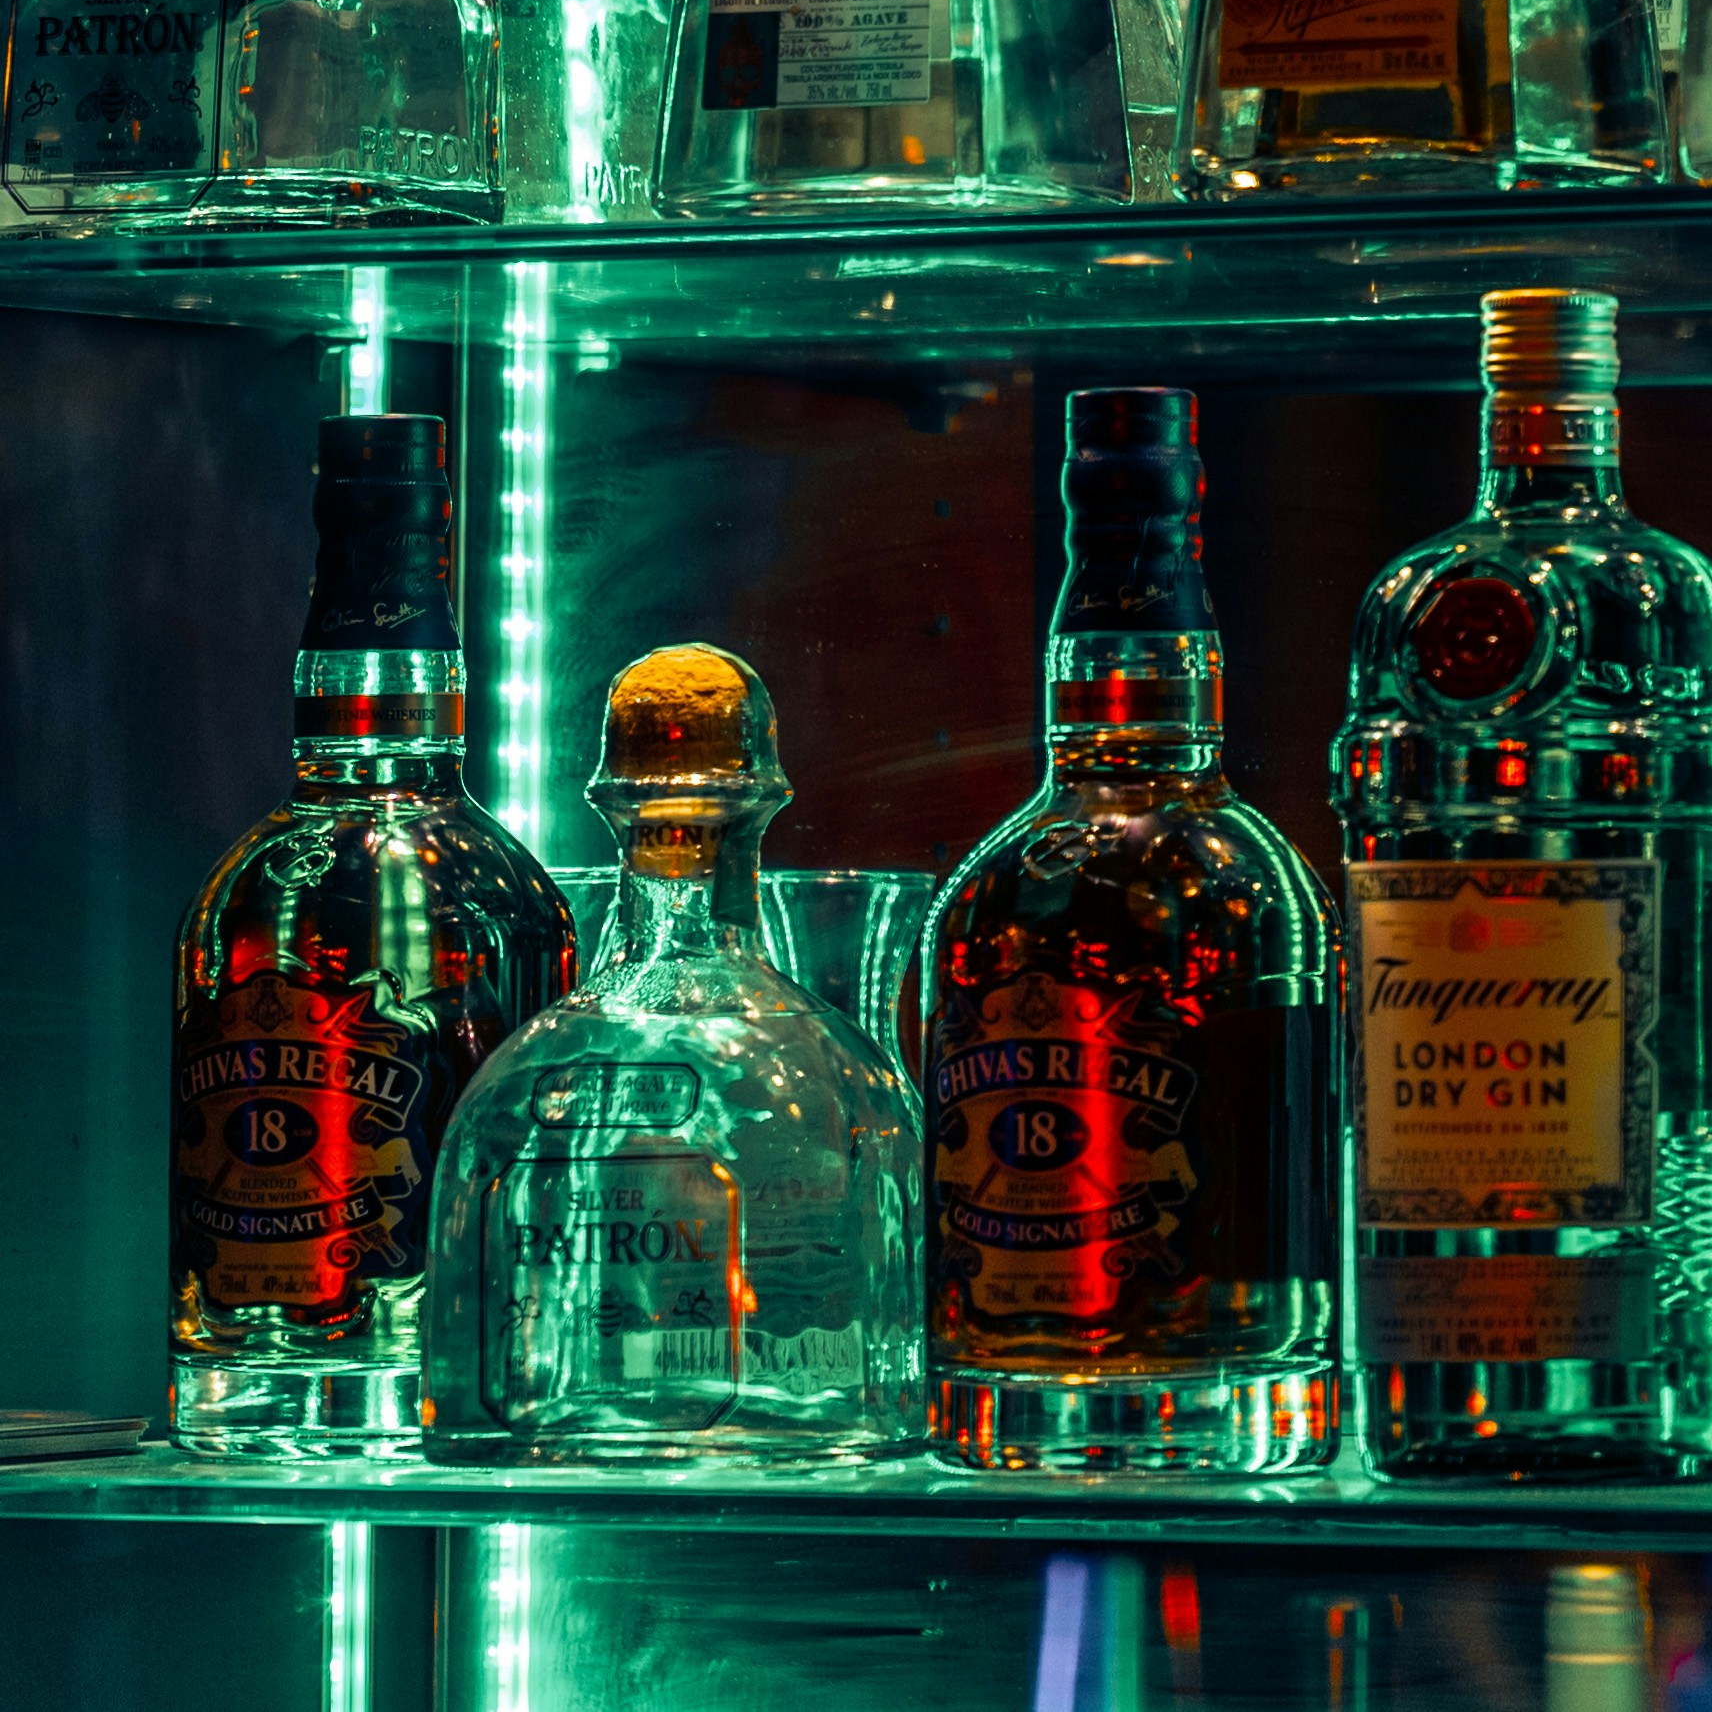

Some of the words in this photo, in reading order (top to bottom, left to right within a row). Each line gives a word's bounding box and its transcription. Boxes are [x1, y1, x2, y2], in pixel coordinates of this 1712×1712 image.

[36, 4, 197, 58] PATRÓN
[851, 12, 908, 26] AGAVE
[1367, 955, 1619, 1026] Tanqueray
[179, 1045, 267, 1104] CHIVAS
[277, 1045, 405, 1105] REGAL
[936, 1044, 1036, 1105] CHIVAS
[1393, 1039, 1570, 1072] LONDON
[1394, 1078, 1466, 1109] DRY
[1486, 1078, 1568, 1109] GIN
[246, 1109, 287, 1154] 18
[1014, 1110, 1058, 1159] 18
[239, 1178, 298, 1190] BLENDED
[267, 1188, 321, 1203] WHISKY
[567, 1188, 645, 1212] SILVER
[191, 1201, 234, 1232] GOLD
[512, 1208, 704, 1266] PATRÓN
[953, 1205, 1002, 1240] GOLD
[1006, 1202, 1146, 1244] SIGNATRE
